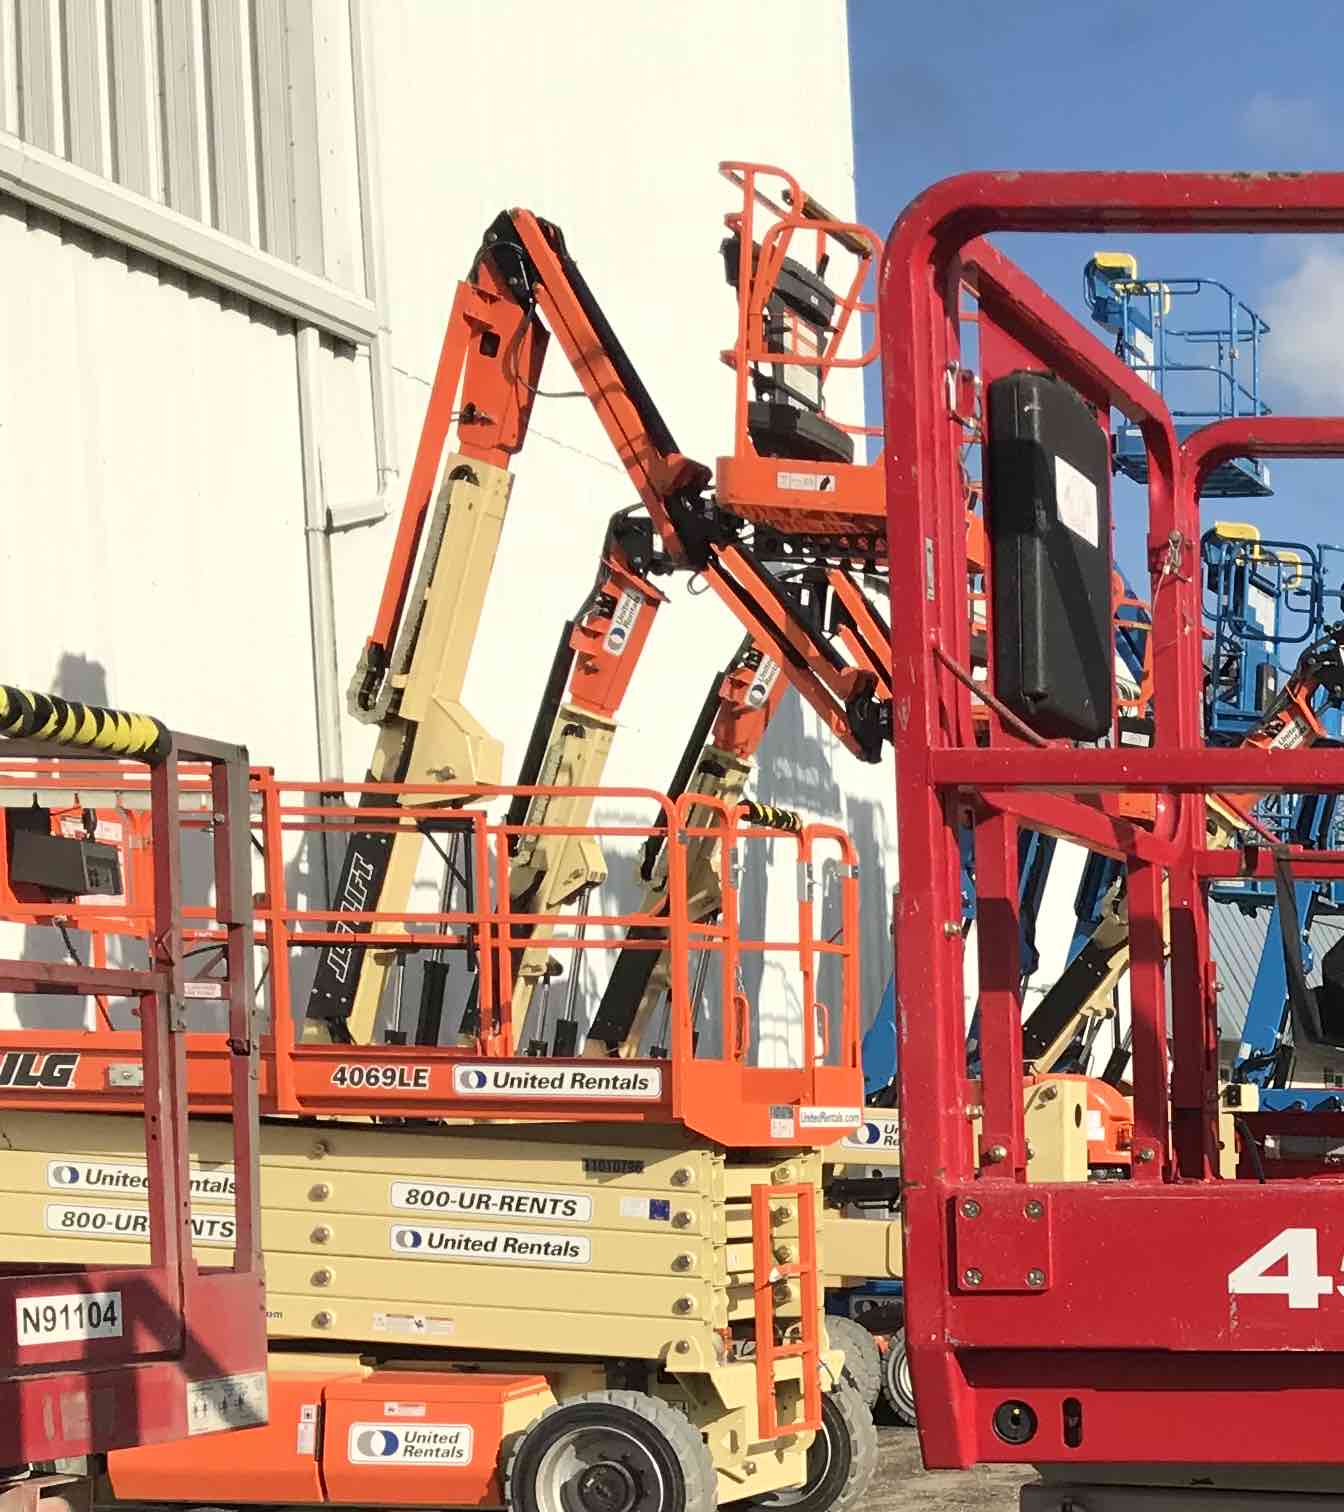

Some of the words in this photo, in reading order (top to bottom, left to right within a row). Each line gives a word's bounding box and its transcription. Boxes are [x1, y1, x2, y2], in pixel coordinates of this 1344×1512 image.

[332, 1065, 430, 1089] 4069LE
[493, 1072, 563, 1090] United
[569, 1073, 649, 1091] Rentals
[405, 1188, 578, 1217] 800-UR-RENTS
[62, 1210, 235, 1238] 800-URNTS
[428, 1230, 497, 1253] United
[503, 1238, 580, 1259] Rentals
[23, 1301, 118, 1334] N91104
[403, 1431, 460, 1445] United
[402, 1445, 464, 1459] Rentals
